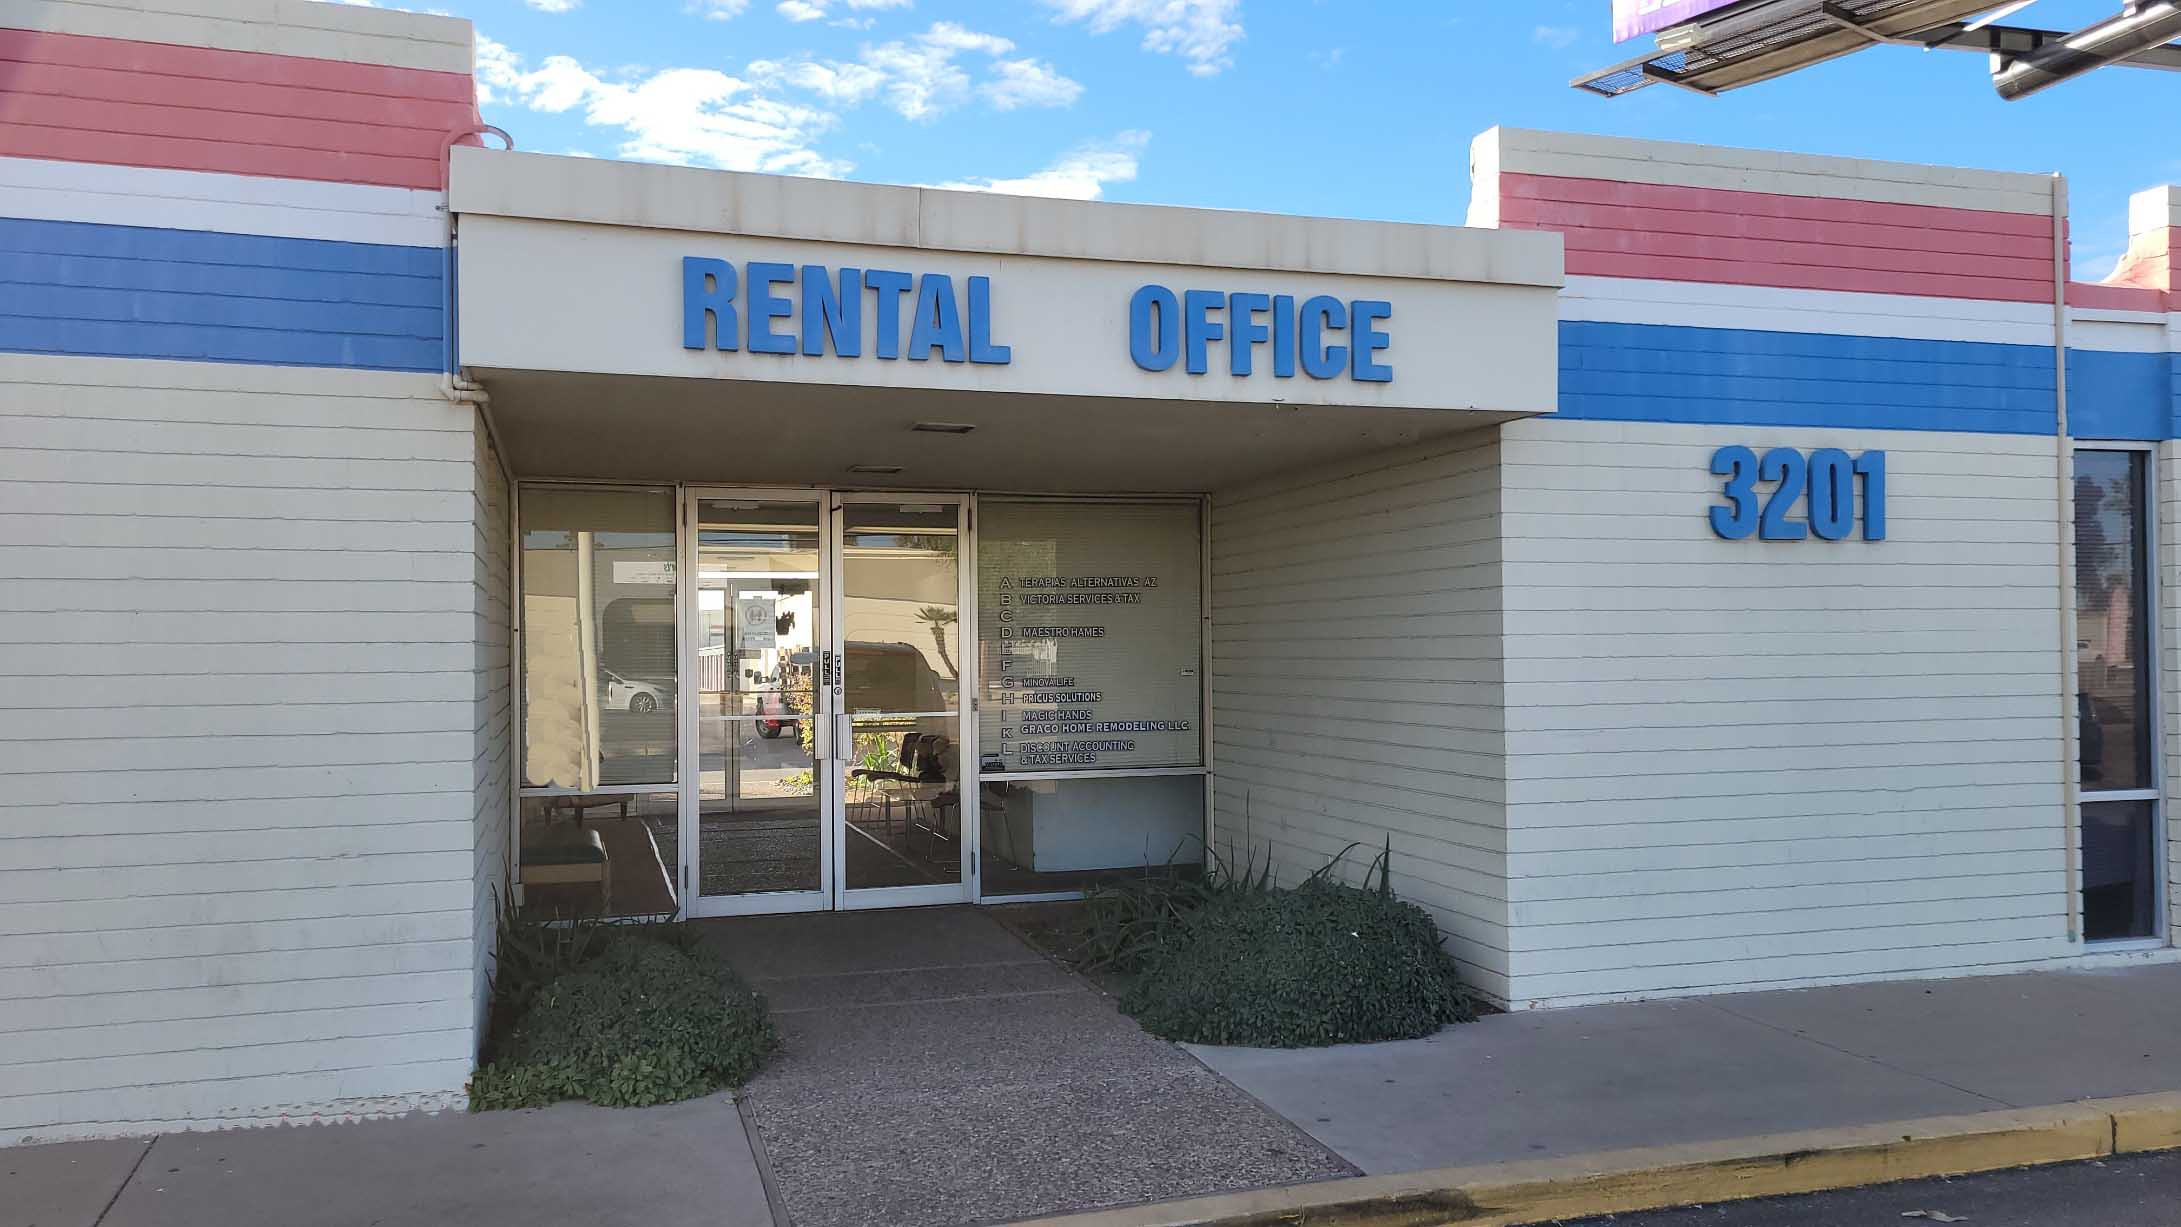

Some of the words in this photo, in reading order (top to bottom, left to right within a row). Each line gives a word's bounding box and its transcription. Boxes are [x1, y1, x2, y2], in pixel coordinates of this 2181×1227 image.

[683, 256, 1011, 364] RENTAL
[1129, 284, 1392, 382] OFFICE
[1709, 445, 1886, 541] 3201
[1000, 577, 1011, 589] A
[1020, 577, 1065, 589] TERAPIAS
[1071, 577, 1139, 588] ALTERNATIVAS
[1144, 577, 1158, 588] AZ
[1001, 594, 1012, 605] B
[1021, 594, 1065, 605] VICTORIA
[1067, 594, 1113, 604] SERVICES
[1115, 593, 1121, 603] &
[1123, 593, 1140, 603] TAX
[1000, 610, 1013, 622] C
[1001, 627, 1013, 638] D
[1023, 627, 1069, 637] MAESTRO
[1071, 627, 1104, 637] HAMES
[1002, 660, 1012, 671] F
[1002, 676, 1014, 688] G
[1002, 692, 1014, 704] H
[1023, 694, 1054, 704] PRICUS
[1055, 692, 1101, 703] SOLUTIONS
[1023, 711, 1056, 721] MAGIC
[1058, 710, 1092, 720] HANDS
[1002, 728, 1013, 738] K
[1021, 725, 1058, 735] GRACO
[1062, 723, 1092, 733] HOME
[1096, 721, 1165, 732] REMODELING
[1002, 743, 1013, 754] L
[1020, 742, 1069, 753] DISCOUNT
[1072, 740, 1135, 752] ACCOUNTING
[1021, 754, 1028, 765] &
[1030, 753, 1048, 764] TAX
[1050, 752, 1096, 764] SERVICES
